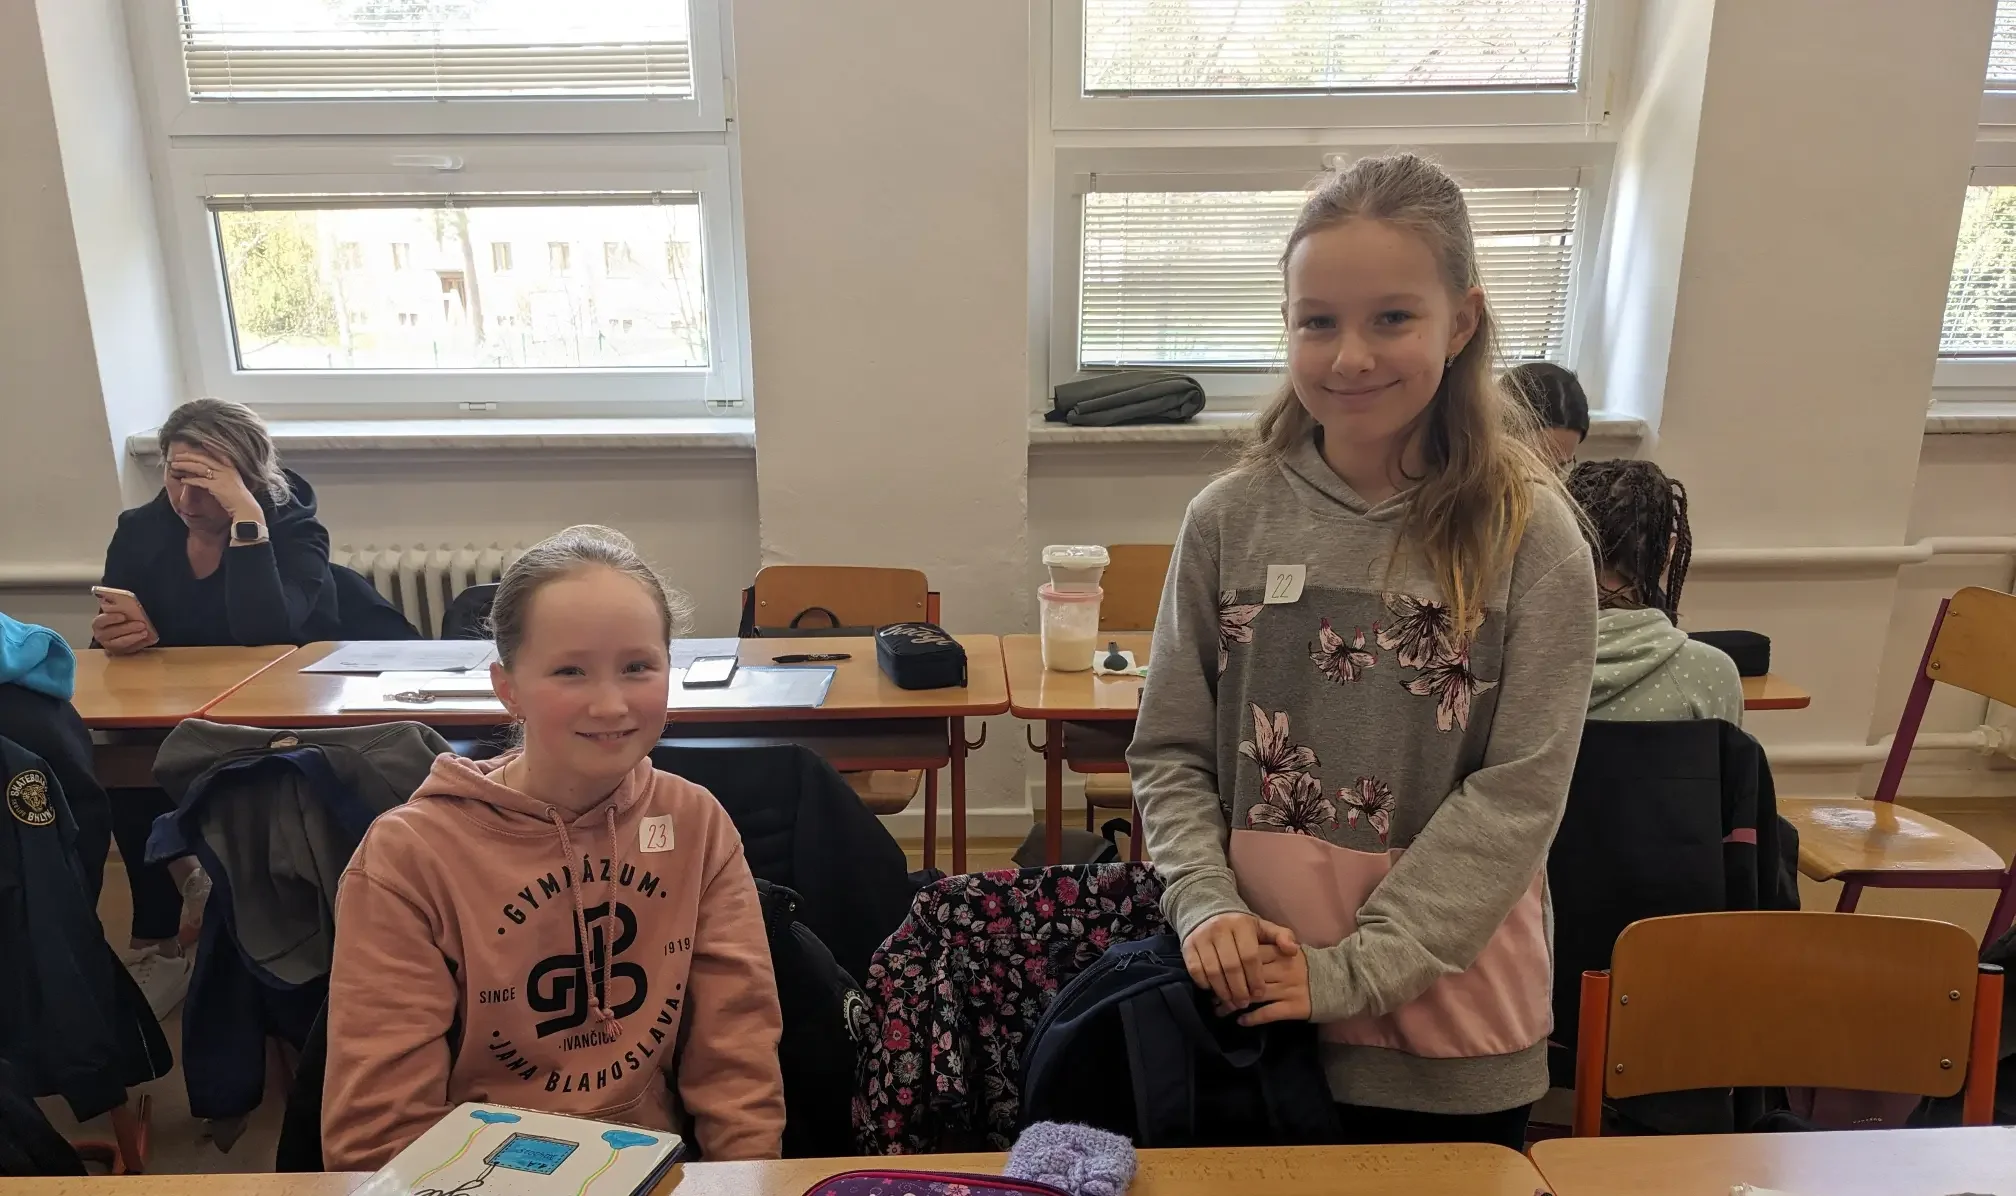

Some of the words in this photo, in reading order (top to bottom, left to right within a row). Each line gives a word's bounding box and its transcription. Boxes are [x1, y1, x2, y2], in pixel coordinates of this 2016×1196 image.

[1271, 573, 1293, 599] 22
[647, 823, 667, 849] 23
[503, 854, 661, 925] GYMÁZUM
[664, 937, 691, 956] 1919
[479, 987, 516, 1004] SINCE
[489, 1039, 538, 1081] JANA
[545, 997, 681, 1092] BLAHOSLAVA
